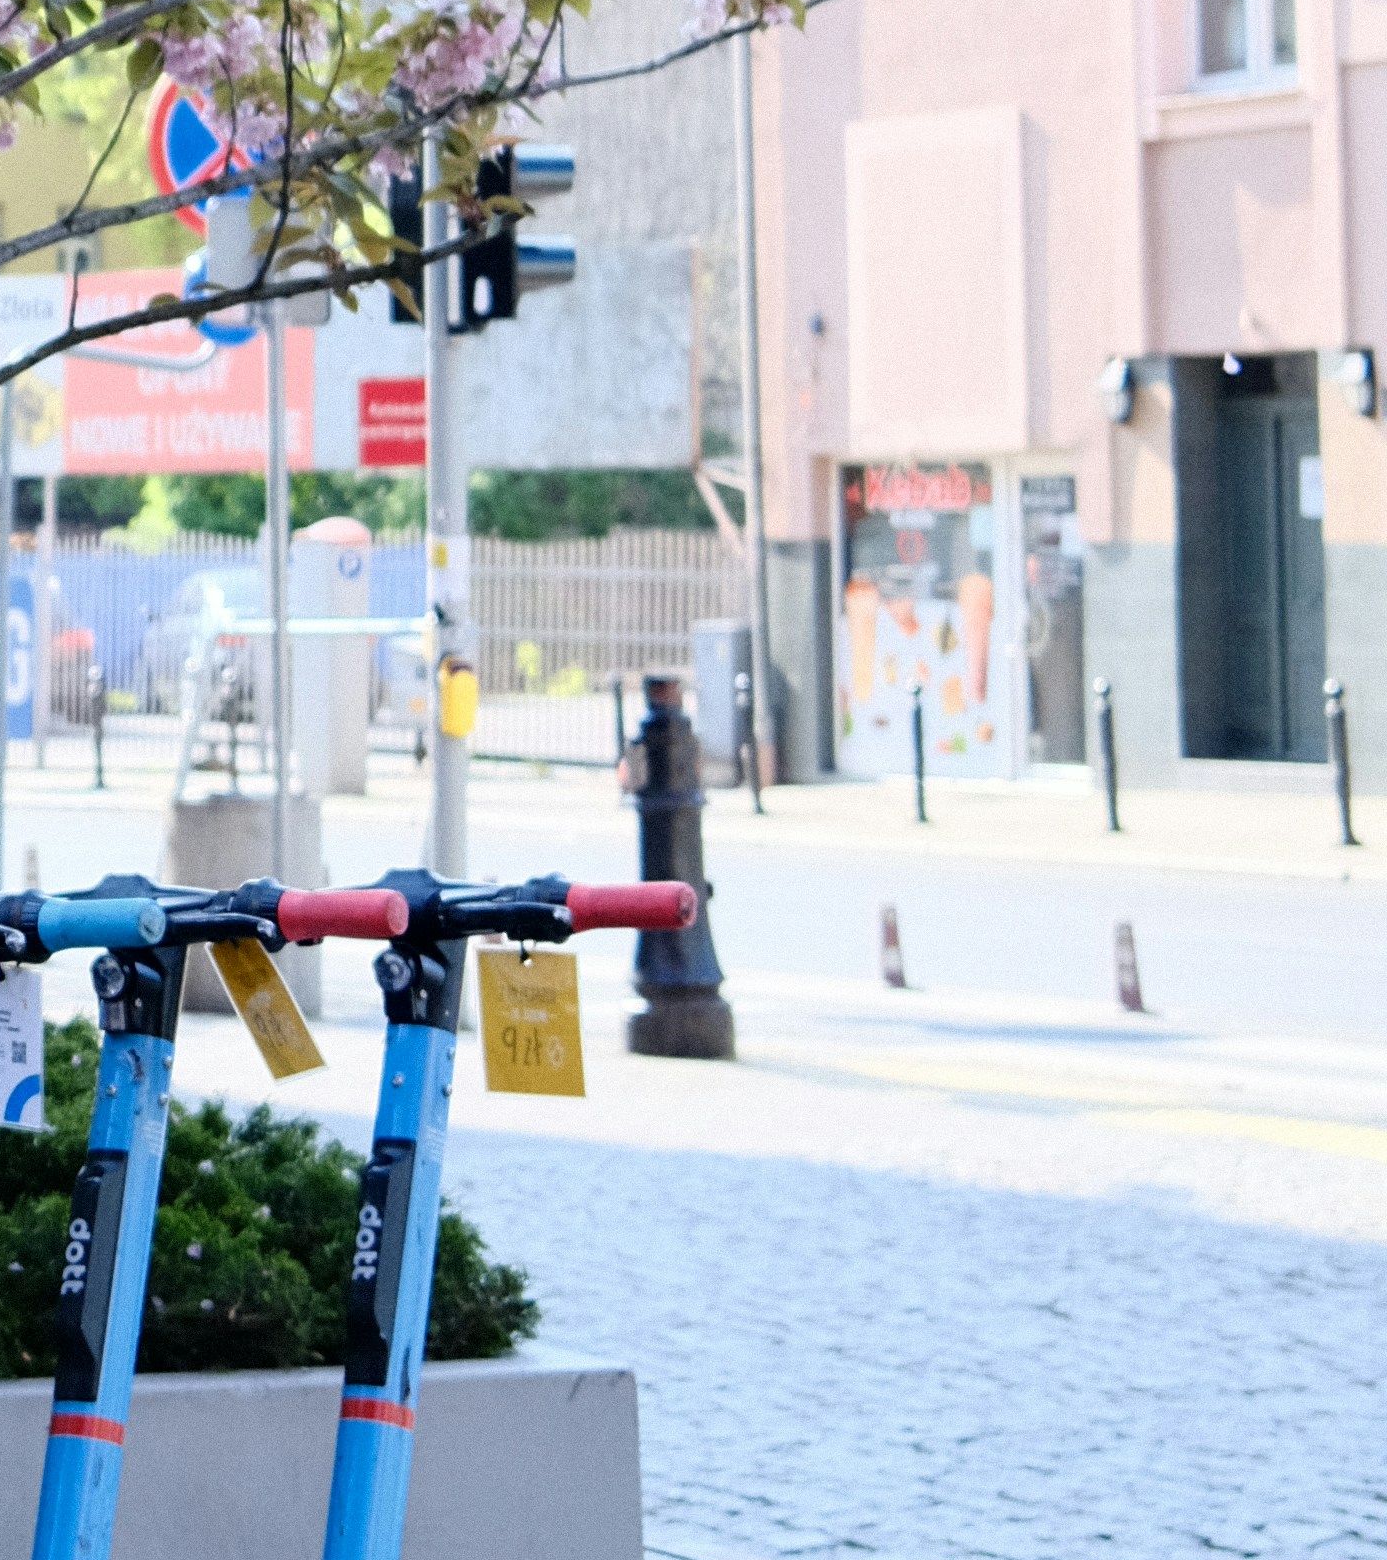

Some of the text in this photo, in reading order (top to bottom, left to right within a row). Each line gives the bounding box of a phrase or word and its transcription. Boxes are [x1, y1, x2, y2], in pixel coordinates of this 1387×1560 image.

[169, 405, 300, 455] UŻYWAE
[60, 1217, 91, 1295] dott
[351, 1203, 382, 1281] dott
